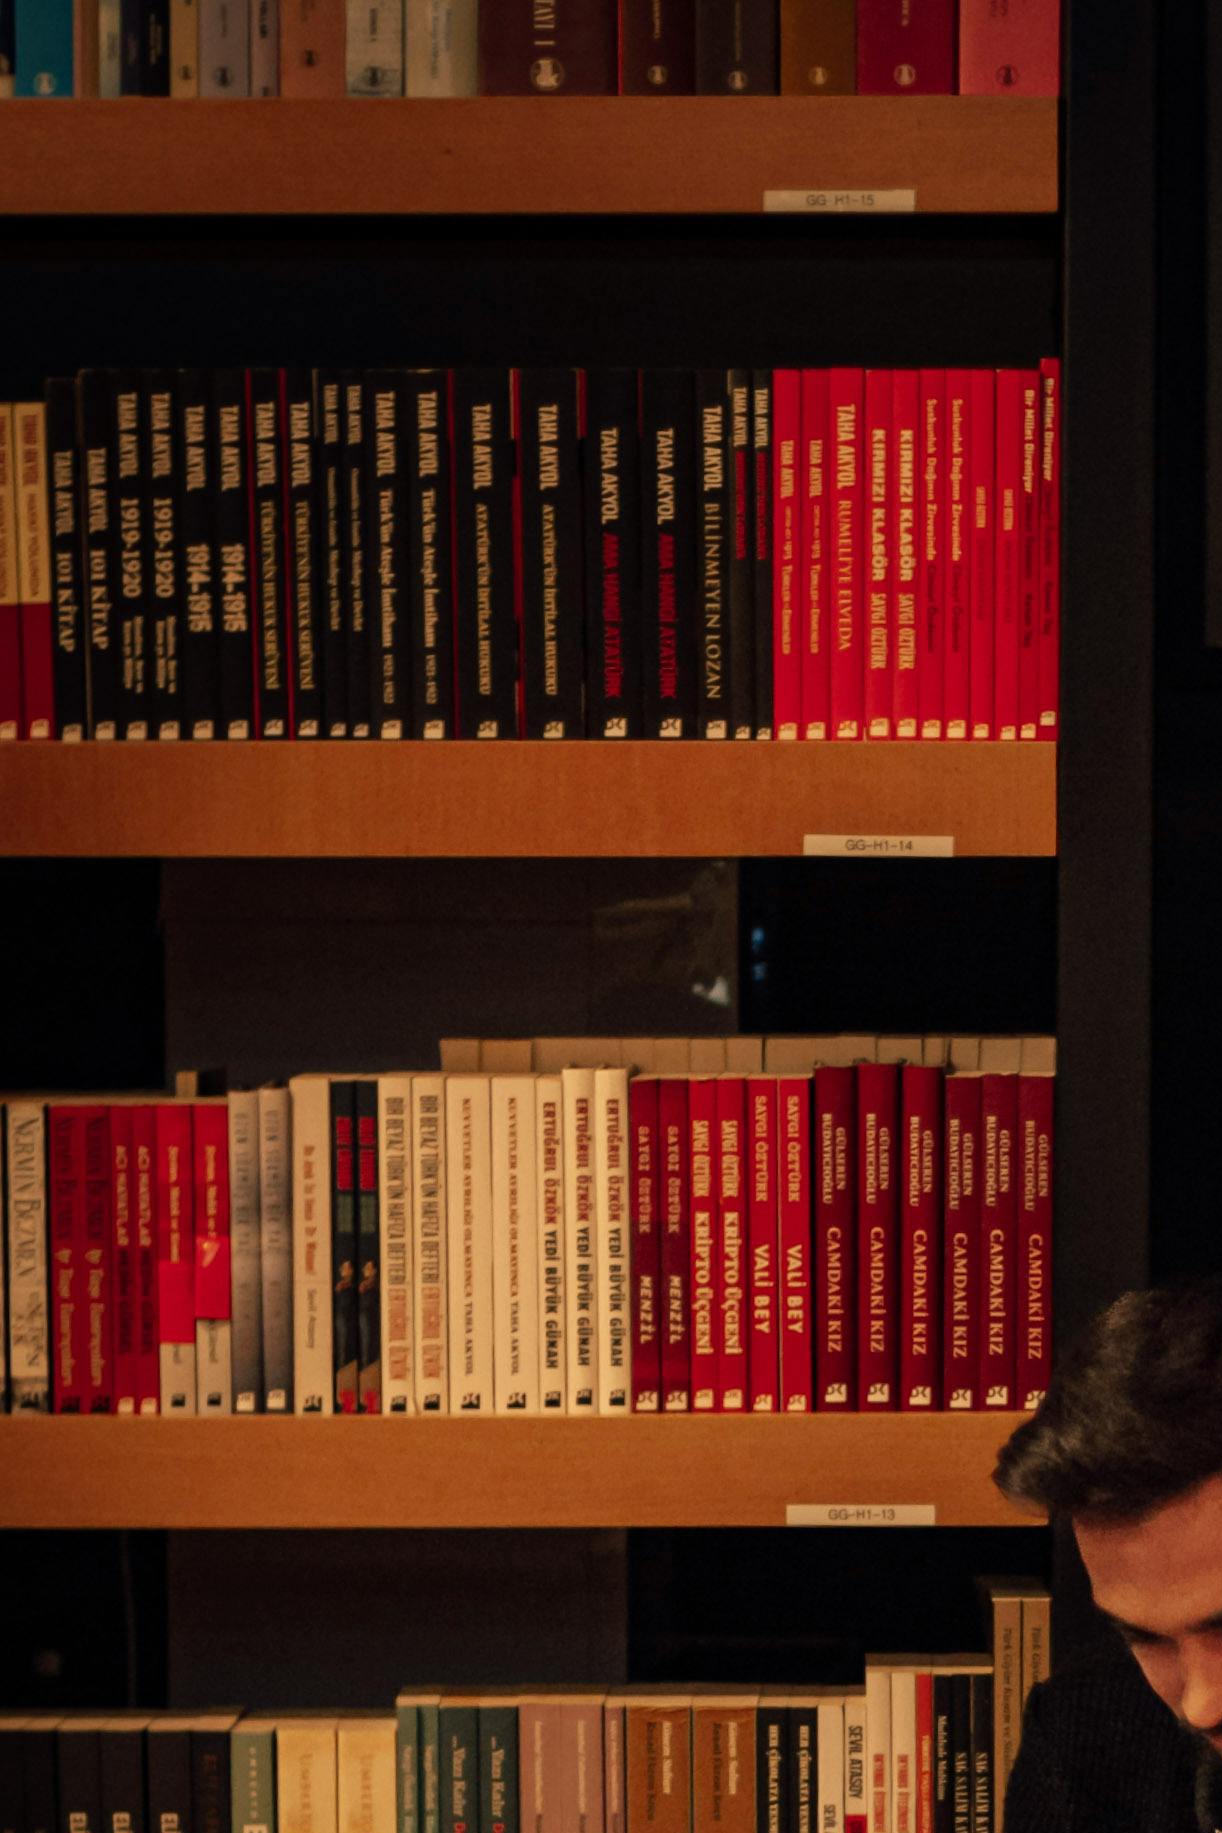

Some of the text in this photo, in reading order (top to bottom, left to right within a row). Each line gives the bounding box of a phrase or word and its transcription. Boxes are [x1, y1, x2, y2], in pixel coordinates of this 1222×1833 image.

[118, 392, 137, 430] TAHA
[151, 393, 170, 430] TAHA
[376, 391, 396, 478] TAHA AKYOL
[418, 392, 438, 477] TAHA AKYOL
[733, 387, 747, 414] TAHA
[733, 417, 747, 447] AKYOL
[754, 388, 768, 415] TAHA
[754, 418, 768, 448] AKYOL
[1024, 390, 1035, 406] Bir
[1024, 409, 1035, 441] Millet
[119, 434, 138, 478] AKYOL
[152, 434, 171, 479] AKYOL
[256, 403, 276, 488] TAHA AKYOL
[291, 403, 311, 488] TAHA AKYOL
[472, 404, 492, 489] TAHA AKYOL
[539, 404, 559, 490] TAHA AKYOL
[601, 428, 619, 524] TAHA AKYOL
[657, 429, 674, 525] TAHA AKYOL
[54, 451, 77, 653] TAHA AKYOL 101 KİTAP
[87, 448, 110, 650] TAHA AKYOL 101 KİTAP
[121, 498, 141, 599] 1919-1920
[153, 498, 174, 599] 1919-1920
[185, 406, 212, 633] TAHA AKYOL 1914-1915
[220, 406, 247, 633] TAHA AKYOL 1914-1915
[703, 406, 722, 699] TAHA AKYOL BİLİNMEYEN LOZAN
[837, 405, 856, 651] TAHA AKYOL RUMELİ'YE ELVEDA
[870, 429, 888, 670] KIRMIZI KLASÖR SAYGI ÖZTÜRK
[898, 429, 916, 670] KIRMIZI KLASÖR SAYGI ÖZTÜRK
[846, 839, 914, 852] GG-H1-14
[836, 1127, 846, 1189] GÜLSEREN
[879, 1127, 890, 1189] GÜLSEREN
[923, 1130, 933, 1192] GÜLSEREN
[963, 1132, 973, 1195] GÜLSEREN
[1000, 1130, 1010, 1192] GÜLSEREN
[1038, 1134, 1048, 1197] GÜLSEREN
[544, 1102, 561, 1369] ERTUĞRUL ÖZKÖK YEDİ BÜYÜK GÜNAH
[576, 1098, 593, 1366] ERTUĞRUL ÖZKÖK YEDİ BÜYÜK GÜNAH
[607, 1099, 626, 1367] ERTUĞRUL ÖZKÖK YEDİ BÜYÜK GÜNAH
[692, 1120, 713, 1355] SAYGI ÖZTÜRK KRİPTO ÜÇGENİ
[721, 1120, 742, 1355] SAYGI ÖZTÜRK KRİPTO ÜÇGENİ
[754, 1095, 774, 1333] SAYGI ÖZTÜRK VALİ BEY
[787, 1095, 806, 1333] SAYGI ÖZTÜRK VALİ BEY
[640, 1275, 655, 1344] MENZİL
[669, 1275, 684, 1344] MENZİL
[827, 1227, 842, 1352] CAMDAKİ KIZ
[870, 1227, 884, 1352] CAMDAKİ KIZ
[912, 1229, 927, 1355] CAMDAKİ KIZ
[953, 1232, 968, 1358] CAMDAKİ KIZ
[989, 1228, 1004, 1355] CAMDAKİ KIZ
[1028, 1233, 1043, 1359] CAMDAKİ KIZ
[828, 1508, 896, 1521] GG-H1-13
[848, 1726, 863, 1799] SEVİL ATASOY
[824, 1805, 836, 1829] SEVİL
